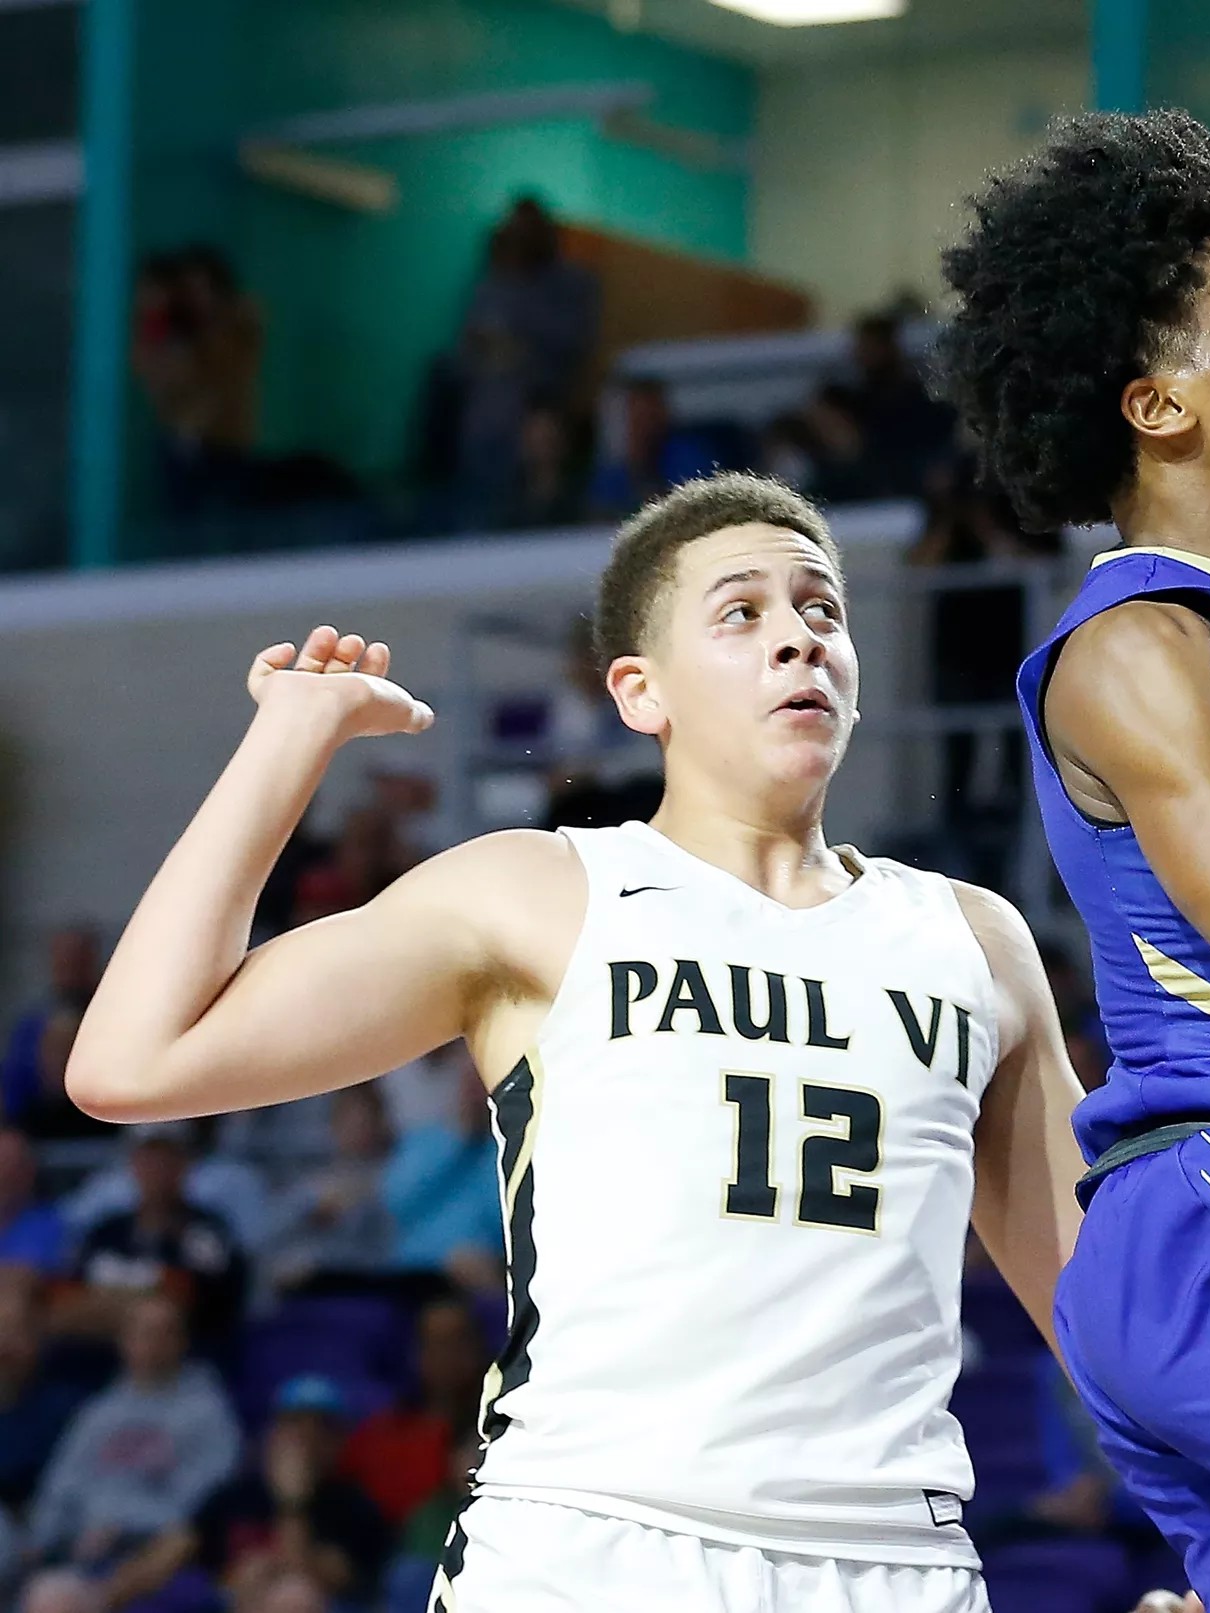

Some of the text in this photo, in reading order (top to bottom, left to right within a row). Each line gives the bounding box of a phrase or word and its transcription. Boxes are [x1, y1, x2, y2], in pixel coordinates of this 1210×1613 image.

[606, 957, 973, 1090] PAUL VI
[719, 1067, 885, 1238] 12
